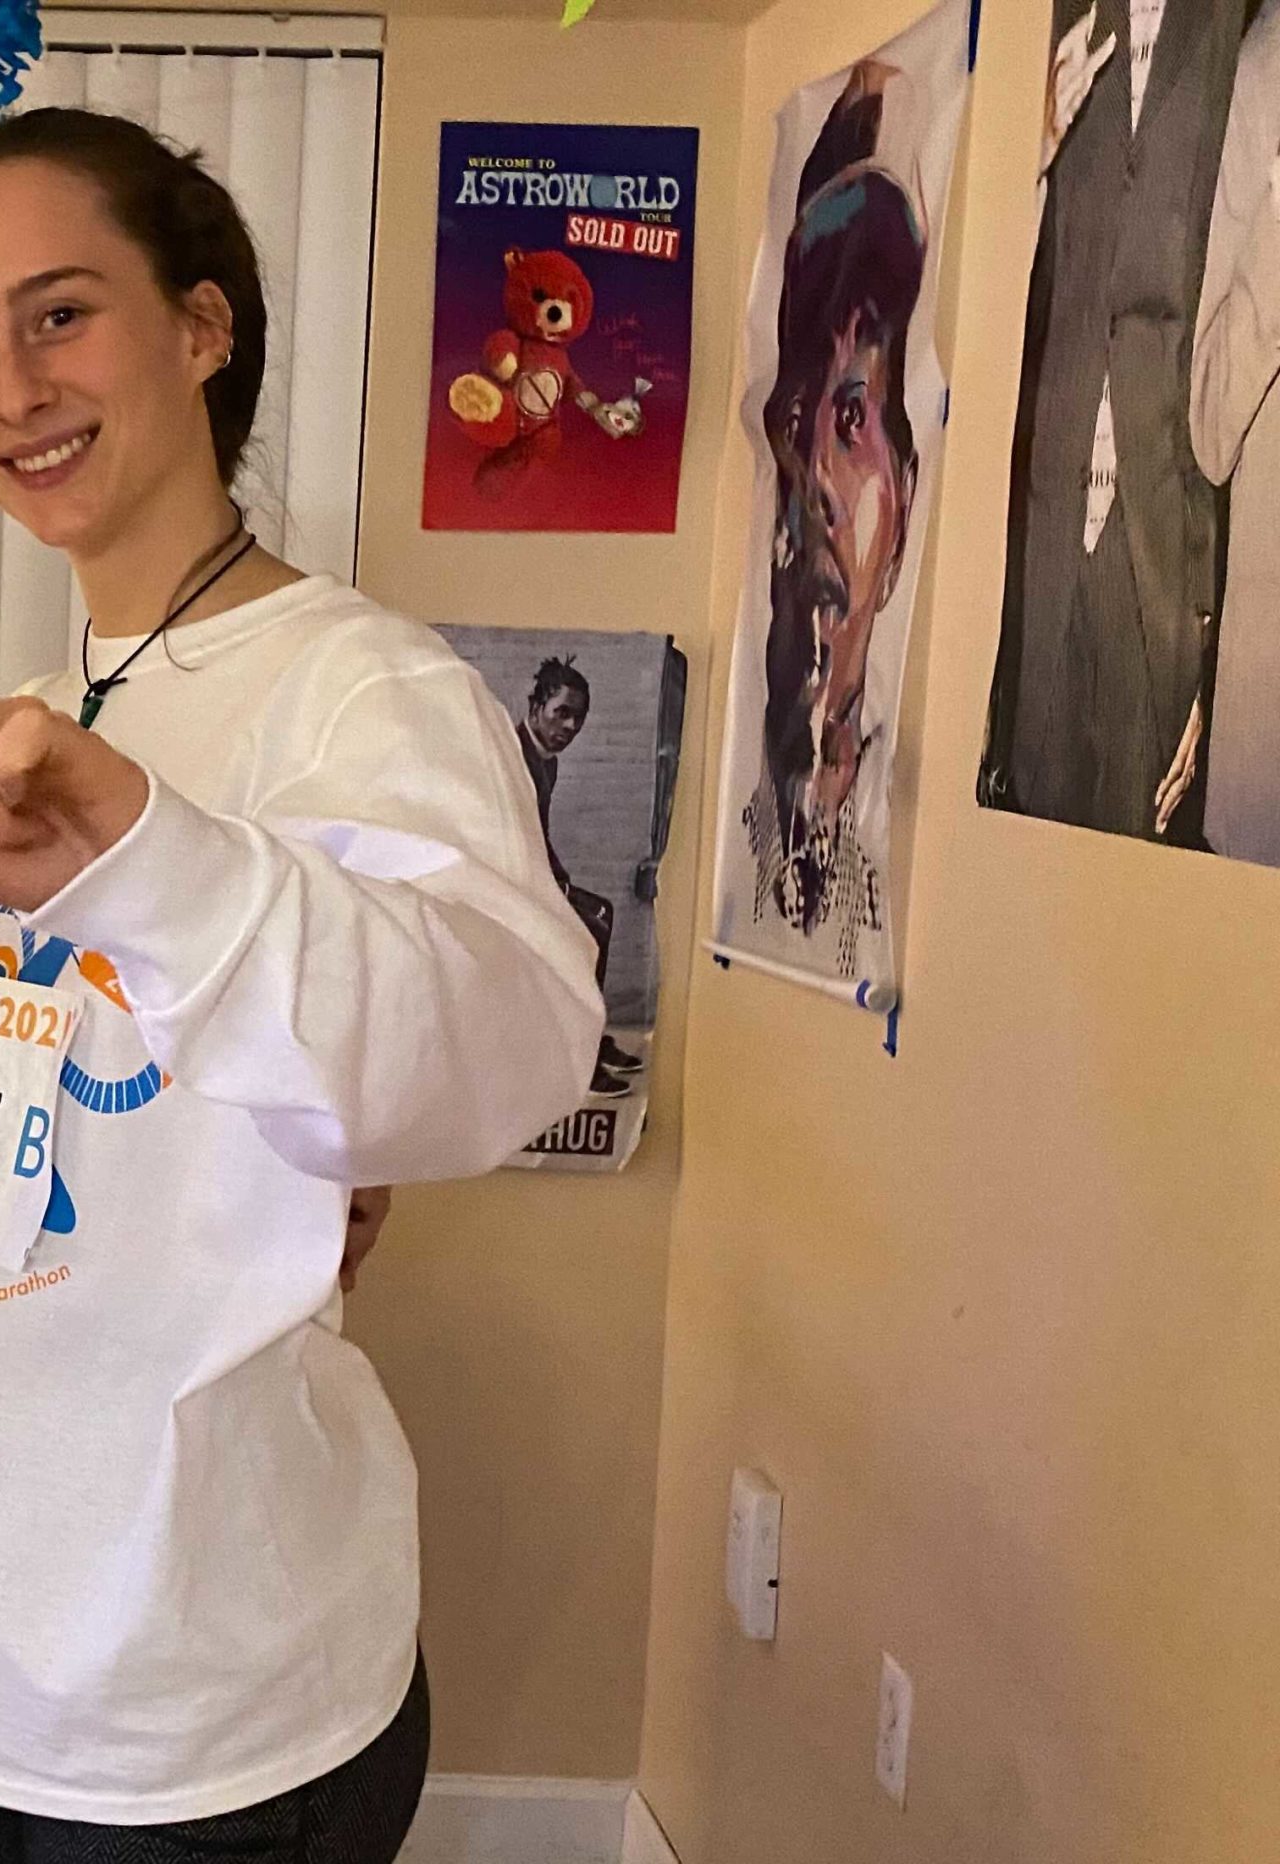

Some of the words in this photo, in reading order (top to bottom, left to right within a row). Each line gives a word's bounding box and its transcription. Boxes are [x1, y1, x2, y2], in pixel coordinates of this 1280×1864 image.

[468, 157, 532, 169] WELCOME
[539, 159, 556, 170] TO
[568, 215, 625, 248] SOLD
[632, 226, 679, 257] OUT
[640, 212, 672, 223] TOUR
[13, 1104, 50, 1179] B
[530, 1112, 609, 1152] HUG
